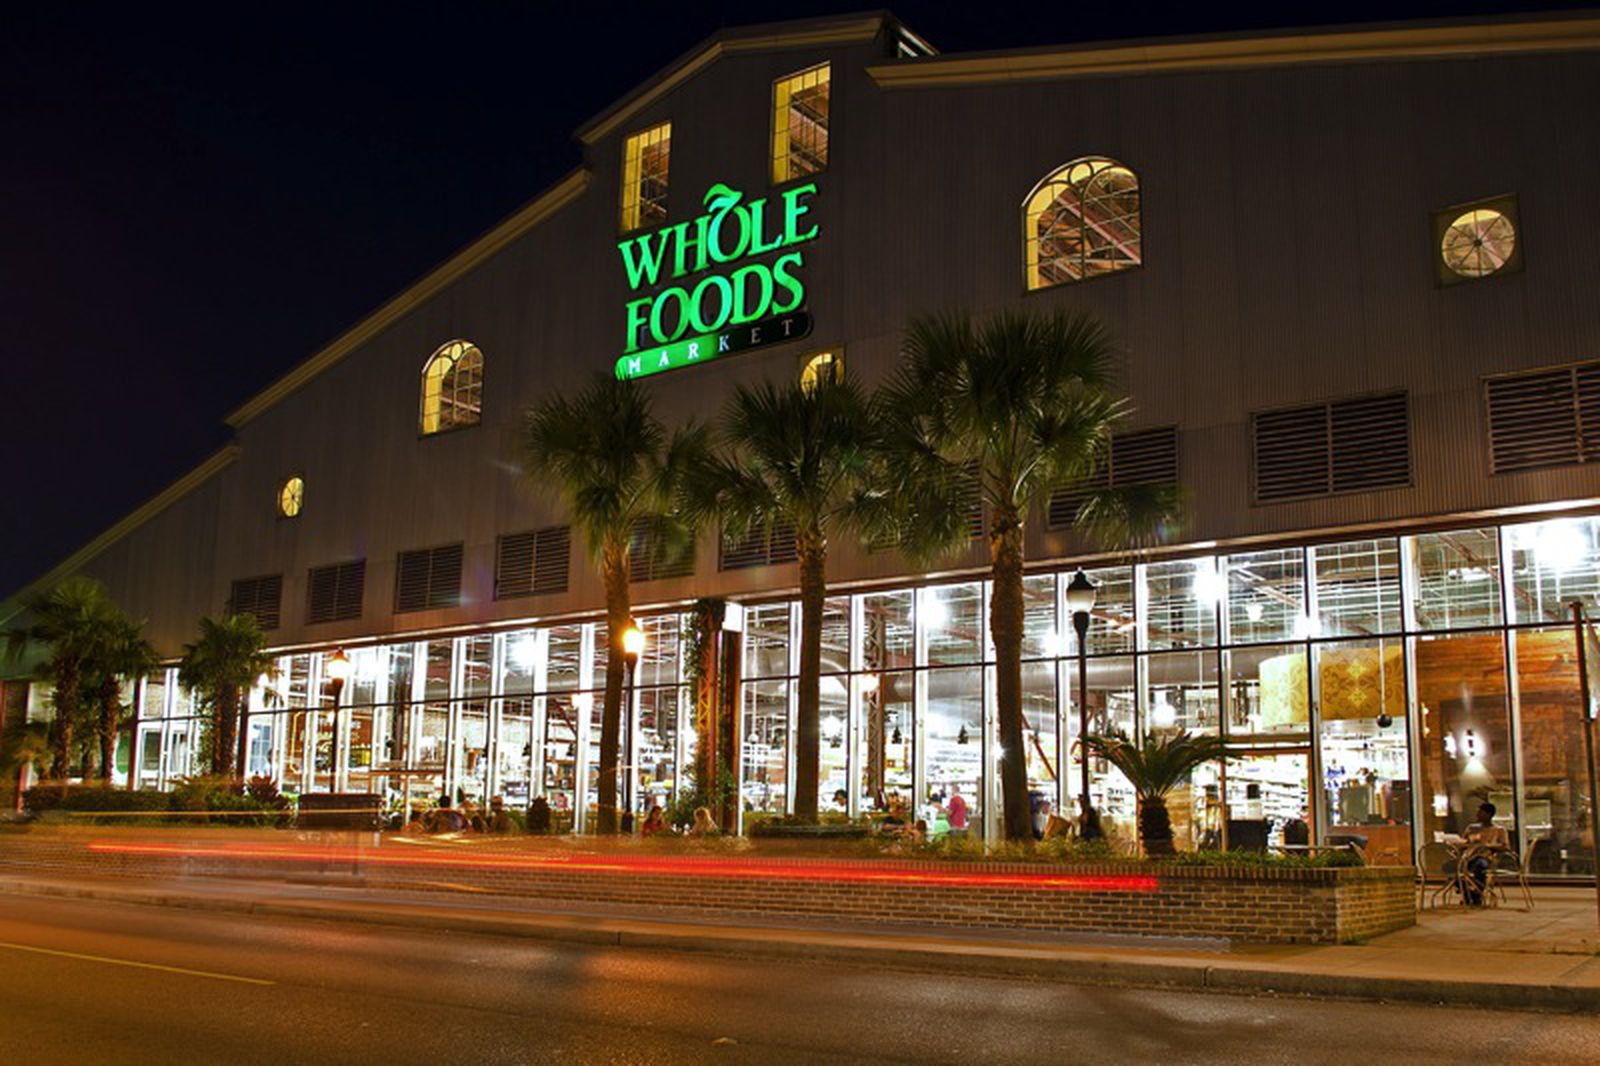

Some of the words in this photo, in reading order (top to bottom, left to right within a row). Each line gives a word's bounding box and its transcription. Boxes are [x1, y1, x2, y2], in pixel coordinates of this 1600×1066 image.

[618, 184, 819, 290] WHOLE
[625, 252, 804, 353] FOODS
[628, 319, 794, 375] MARKET
